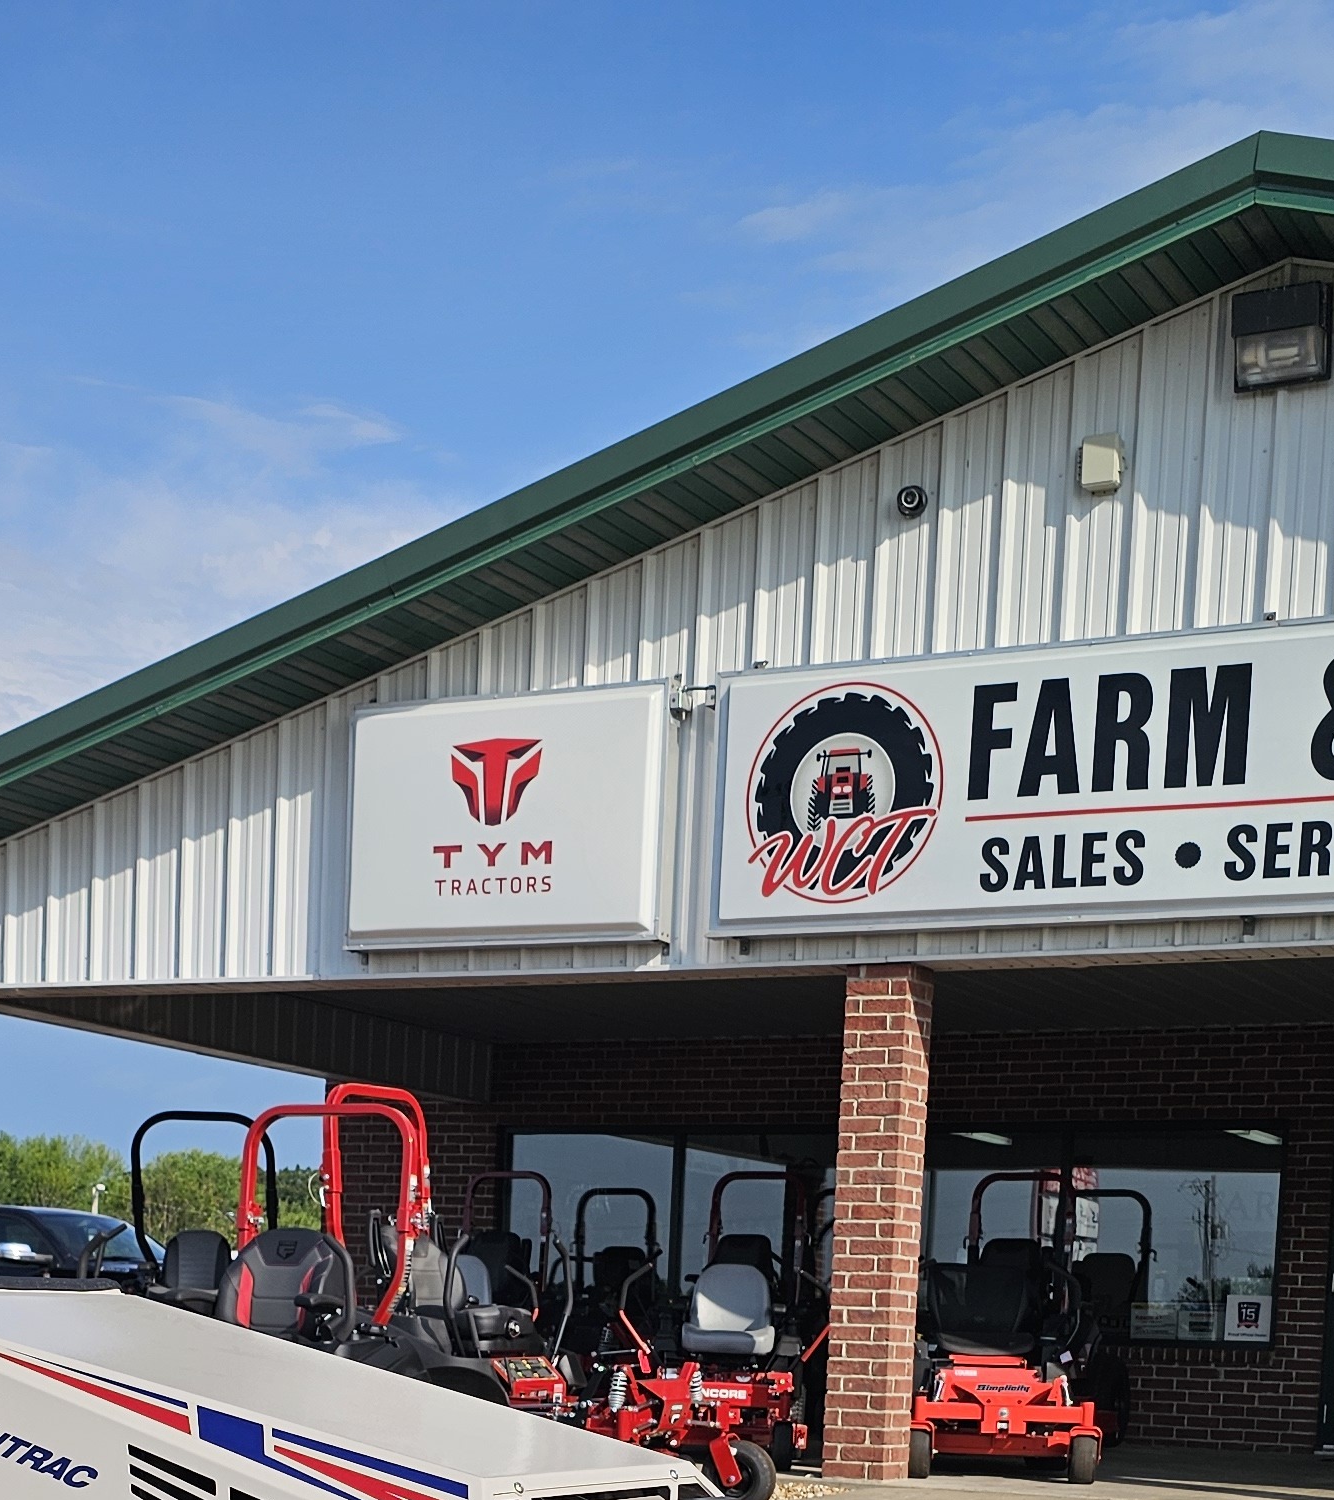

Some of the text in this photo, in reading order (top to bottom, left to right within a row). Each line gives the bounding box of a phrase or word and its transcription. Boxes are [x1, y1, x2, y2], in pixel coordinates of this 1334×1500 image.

[967, 662, 1253, 801] FARM
[433, 840, 553, 869] TYM
[747, 808, 938, 898] WCT
[979, 829, 1146, 893] SALES
[434, 875, 552, 897] TRACTORS
[1240, 1308, 1256, 1321] 15
[700, 1387, 747, 1400] NCORE
[976, 1384, 1031, 1393] Simplicity
